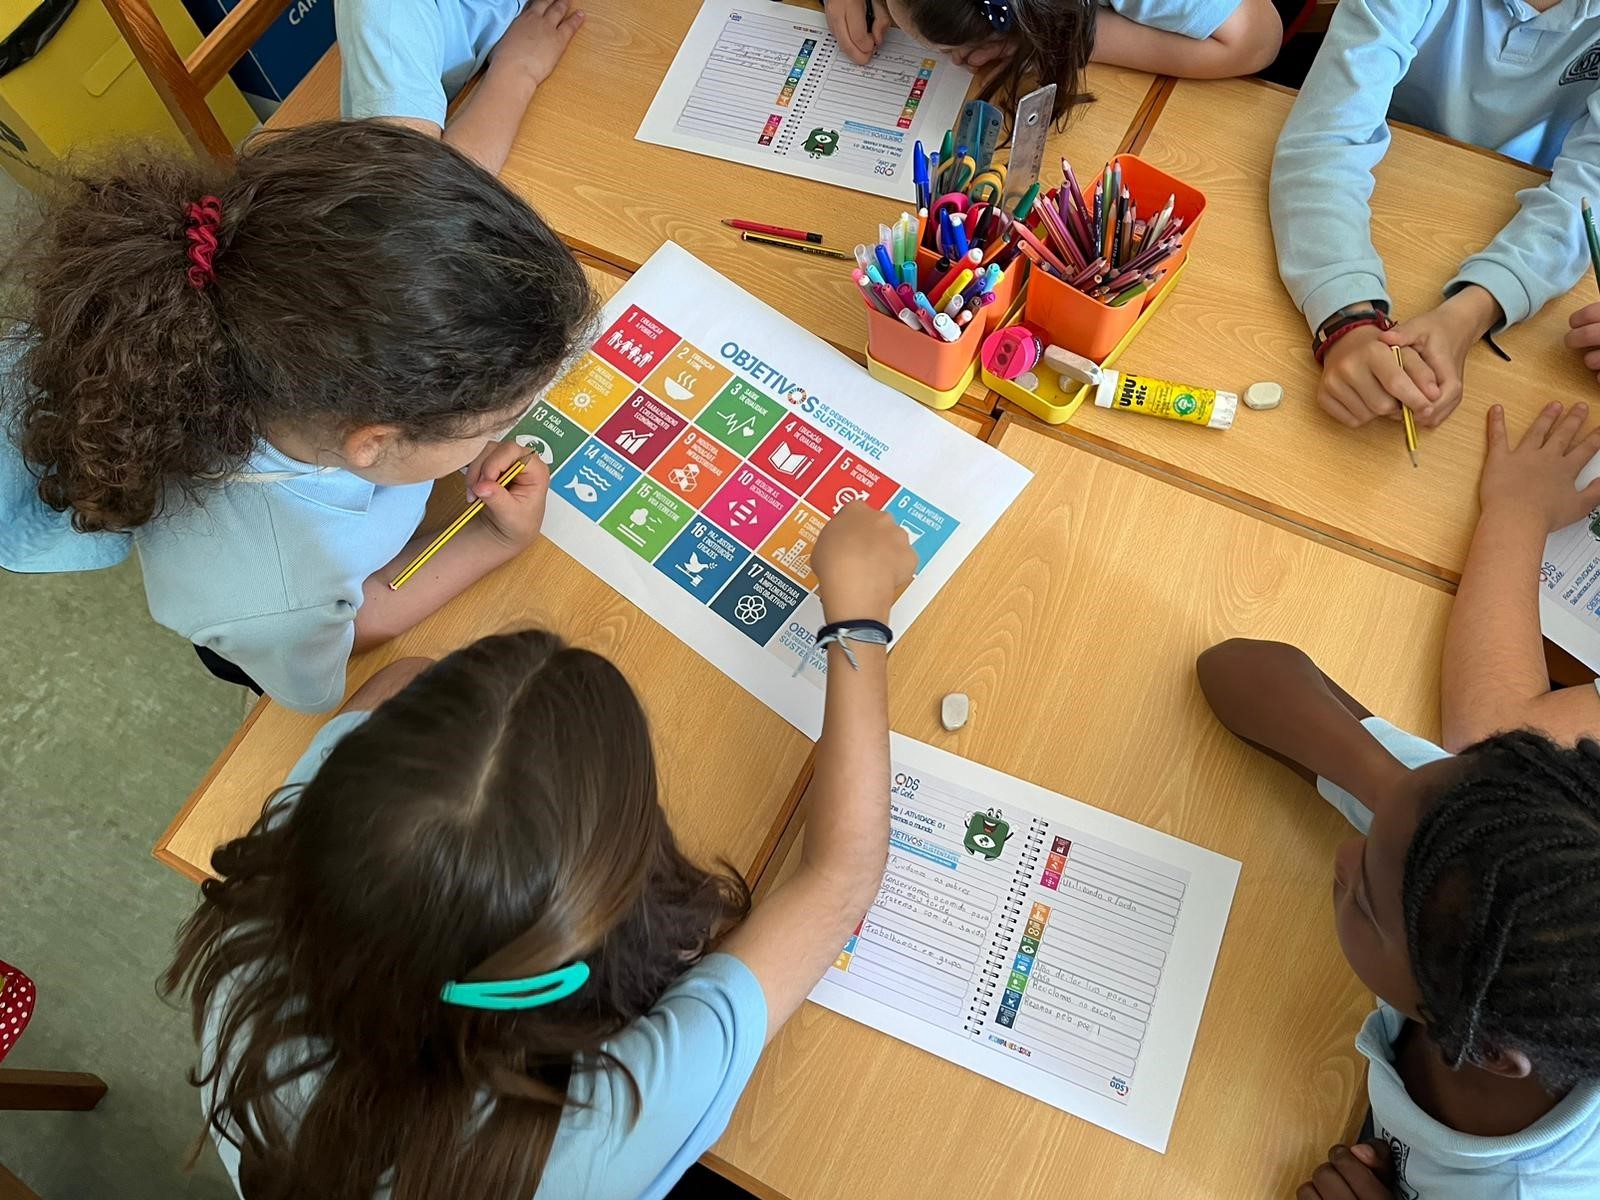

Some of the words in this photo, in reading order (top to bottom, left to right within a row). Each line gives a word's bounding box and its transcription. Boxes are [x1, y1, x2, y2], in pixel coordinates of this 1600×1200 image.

[626, 311, 638, 323] 1
[676, 346, 690, 359] 2
[717, 339, 820, 414] OBJETIVOS
[729, 382, 743, 396] 3
[1119, 378, 1136, 407] UHU
[1133, 384, 1147, 406] stic
[630, 394, 644, 408] 8
[818, 403, 829, 412] DE
[531, 405, 549, 422] 13
[783, 419, 797, 432] 4
[812, 407, 884, 460] SUSTENTÁVEL
[682, 431, 697, 445] 9
[582, 443, 600, 460] 14
[839, 456, 853, 471] 5
[736, 469, 754, 486] 10
[635, 482, 653, 498] 15
[896, 494, 911, 508] 6
[792, 508, 809, 524] 11
[689, 521, 707, 538] 16
[746, 562, 764, 579] 17
[894, 773, 920, 791] ODS
[903, 809, 937, 826] ATIVIDADE
[913, 822, 933, 834] mundo
[1108, 1080, 1125, 1091] ODS
